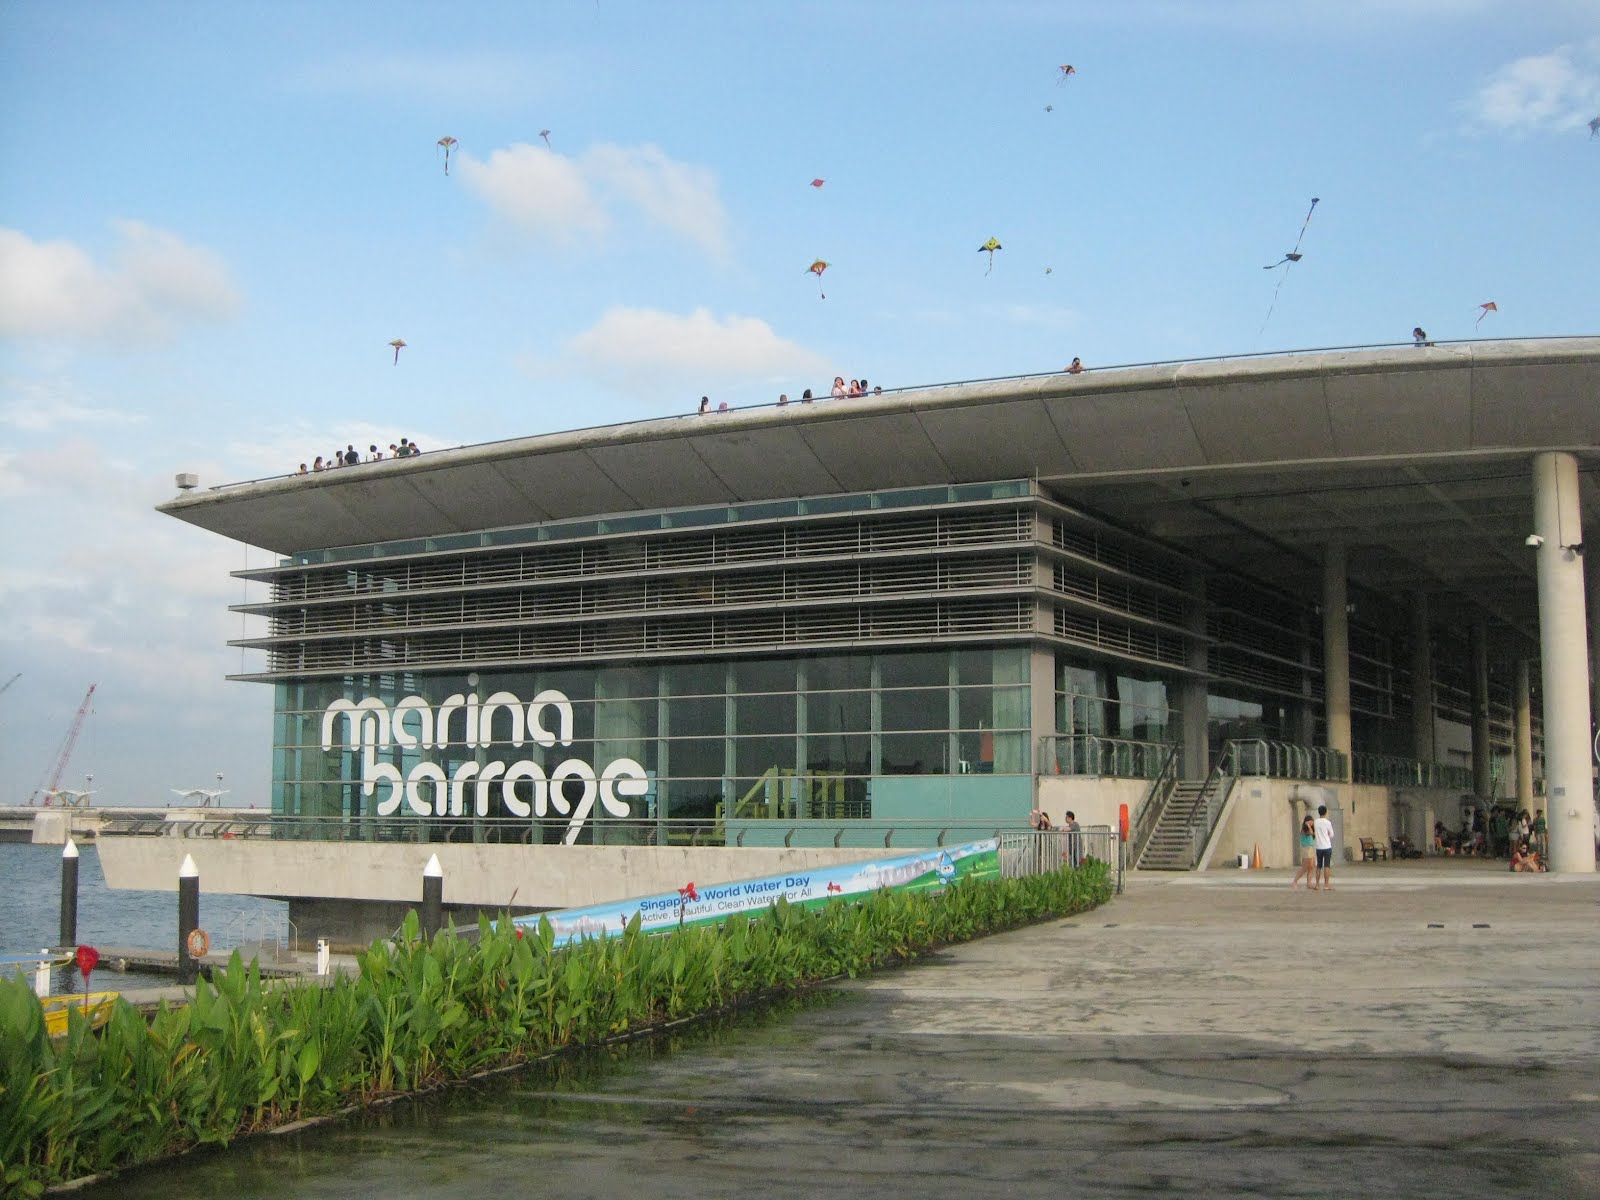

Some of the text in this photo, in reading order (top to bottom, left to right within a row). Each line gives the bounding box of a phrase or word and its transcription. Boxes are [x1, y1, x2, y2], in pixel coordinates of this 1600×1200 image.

[322, 673, 574, 751] marina
[363, 717, 649, 846] barrage
[642, 912, 671, 922] Active,
[717, 900, 745, 911] Clean
[800, 887, 812, 897] All
[704, 886, 740, 900] World
[743, 881, 781, 894] Water
[785, 877, 810, 888] Day
